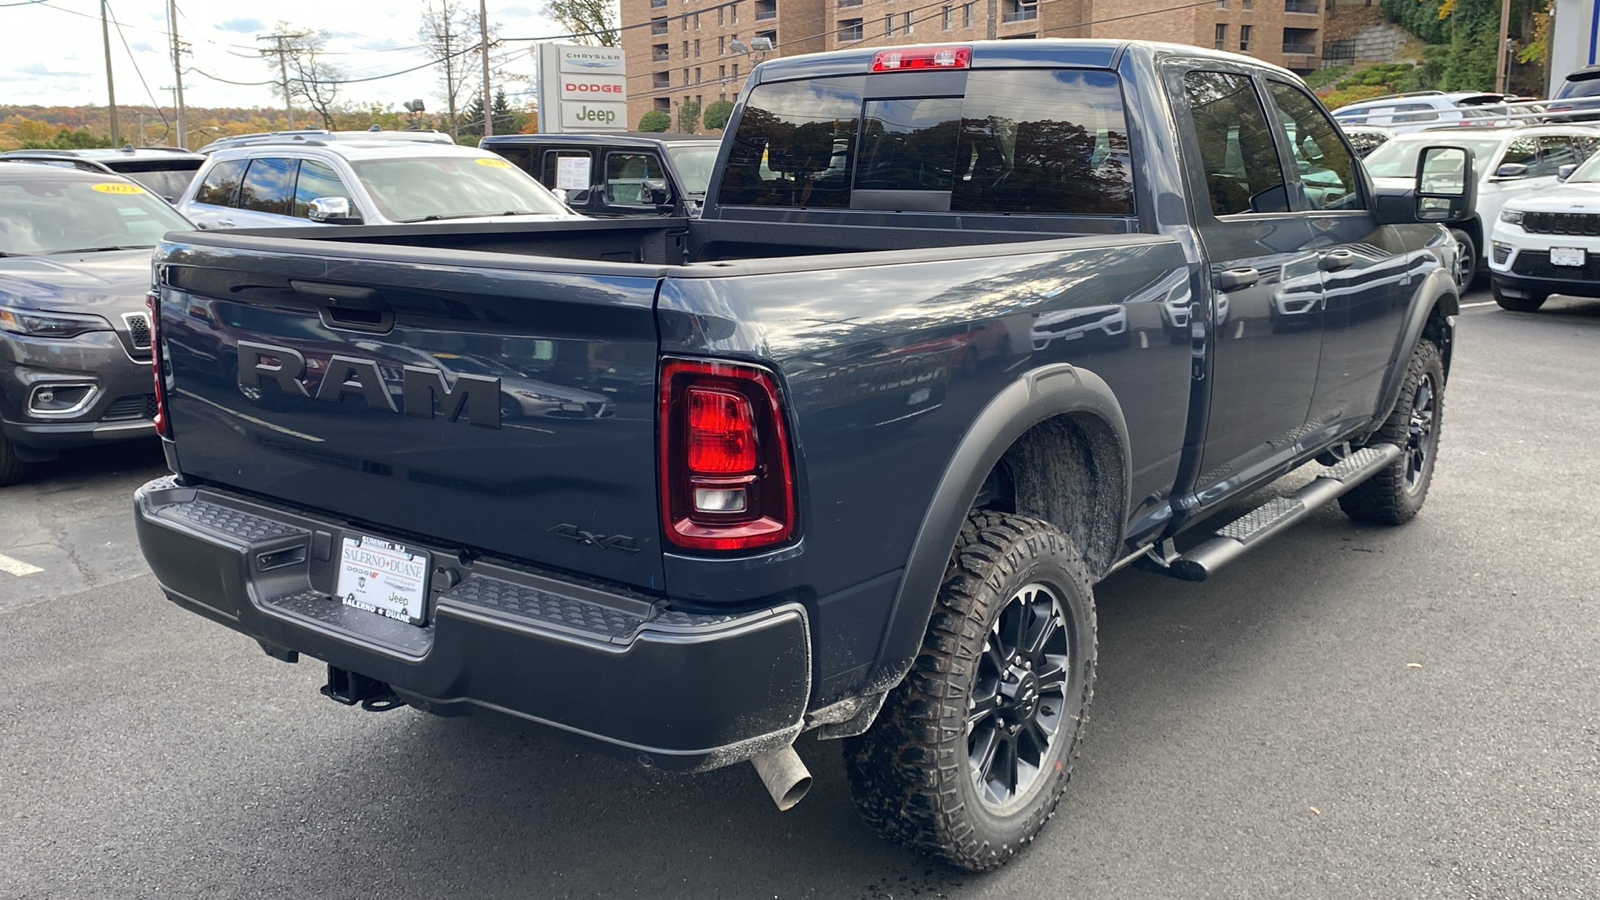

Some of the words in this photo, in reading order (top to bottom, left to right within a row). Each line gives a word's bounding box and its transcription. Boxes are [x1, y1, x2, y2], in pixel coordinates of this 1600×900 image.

[565, 83, 623, 93] DODGE
[576, 105, 616, 124] Jeep
[104, 184, 138, 193] 2022
[237, 339, 502, 430] RAM
[394, 544, 406, 553] NJ
[344, 547, 386, 568] SALERNO
[389, 559, 423, 579] DUANE
[388, 591, 409, 607] Jeep
[341, 597, 376, 613] SALERNO
[385, 609, 411, 624] DUANE
